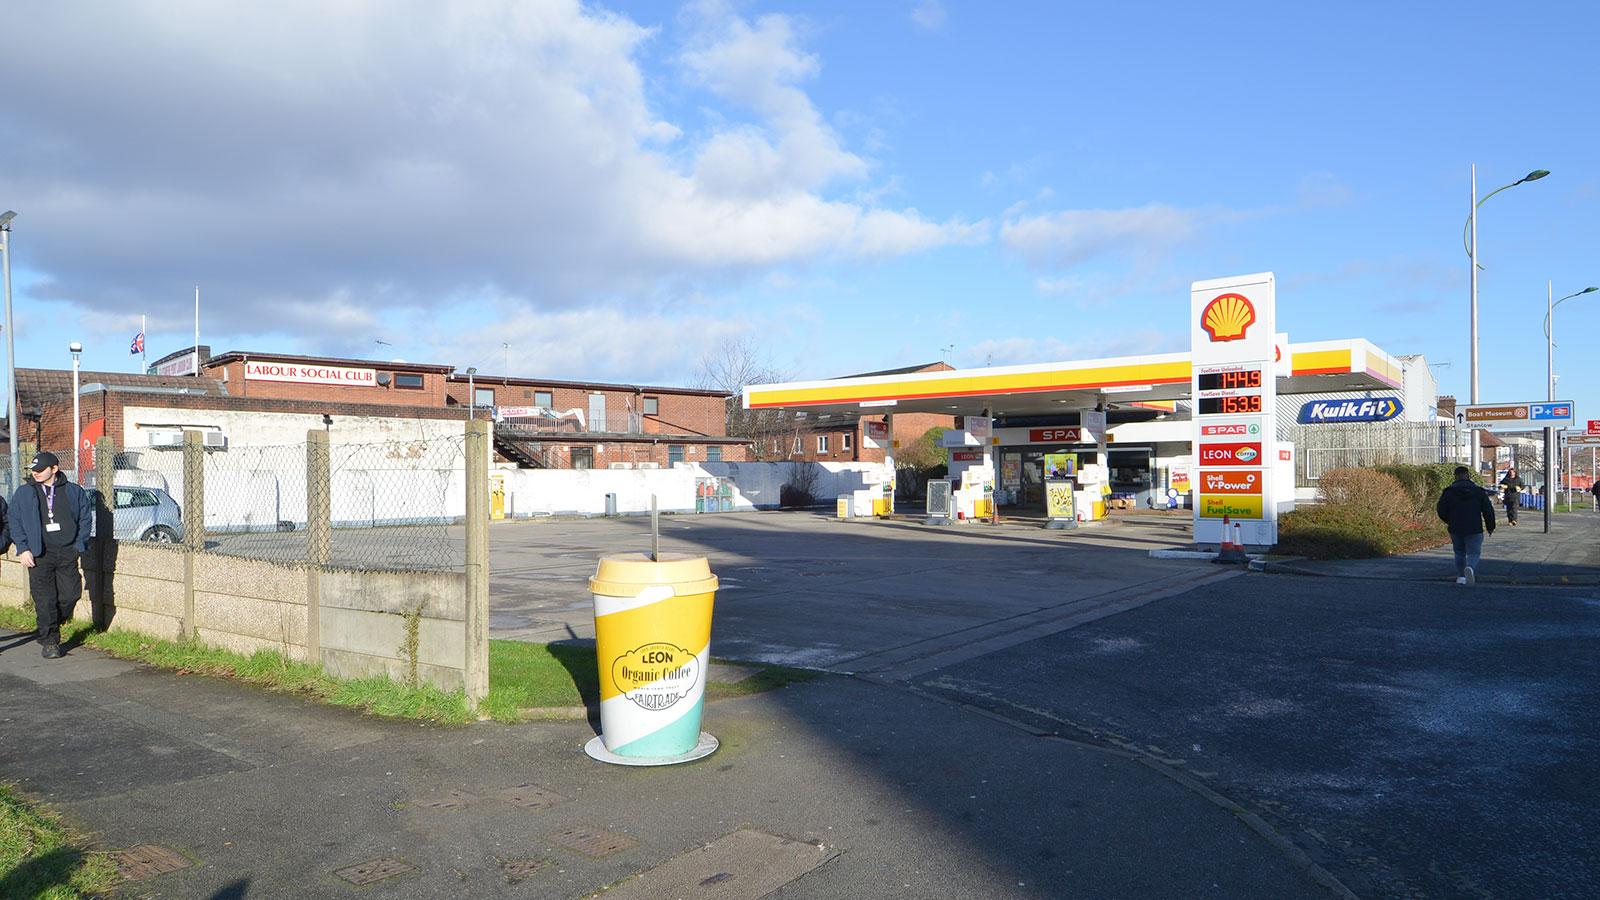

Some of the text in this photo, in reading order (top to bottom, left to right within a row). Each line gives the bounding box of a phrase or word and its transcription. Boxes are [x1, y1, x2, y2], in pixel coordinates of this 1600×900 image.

[247, 364, 373, 381] LABOUR SOCIAL CLUB
[1222, 371, 1261, 389] 144.9
[1222, 396, 1261, 413] 153.9
[1310, 400, 1387, 419] Kwik Fit
[1042, 430, 1082, 440] SPA
[1207, 425, 1246, 434] SPAR
[1203, 449, 1232, 459] LEON
[1206, 481, 1252, 490] V-Power
[1206, 505, 1252, 515] FuelSave
[642, 651, 673, 664] LEON
[622, 665, 691, 684] Organic Coffee
[635, 692, 680, 709] FAIRTRADE
